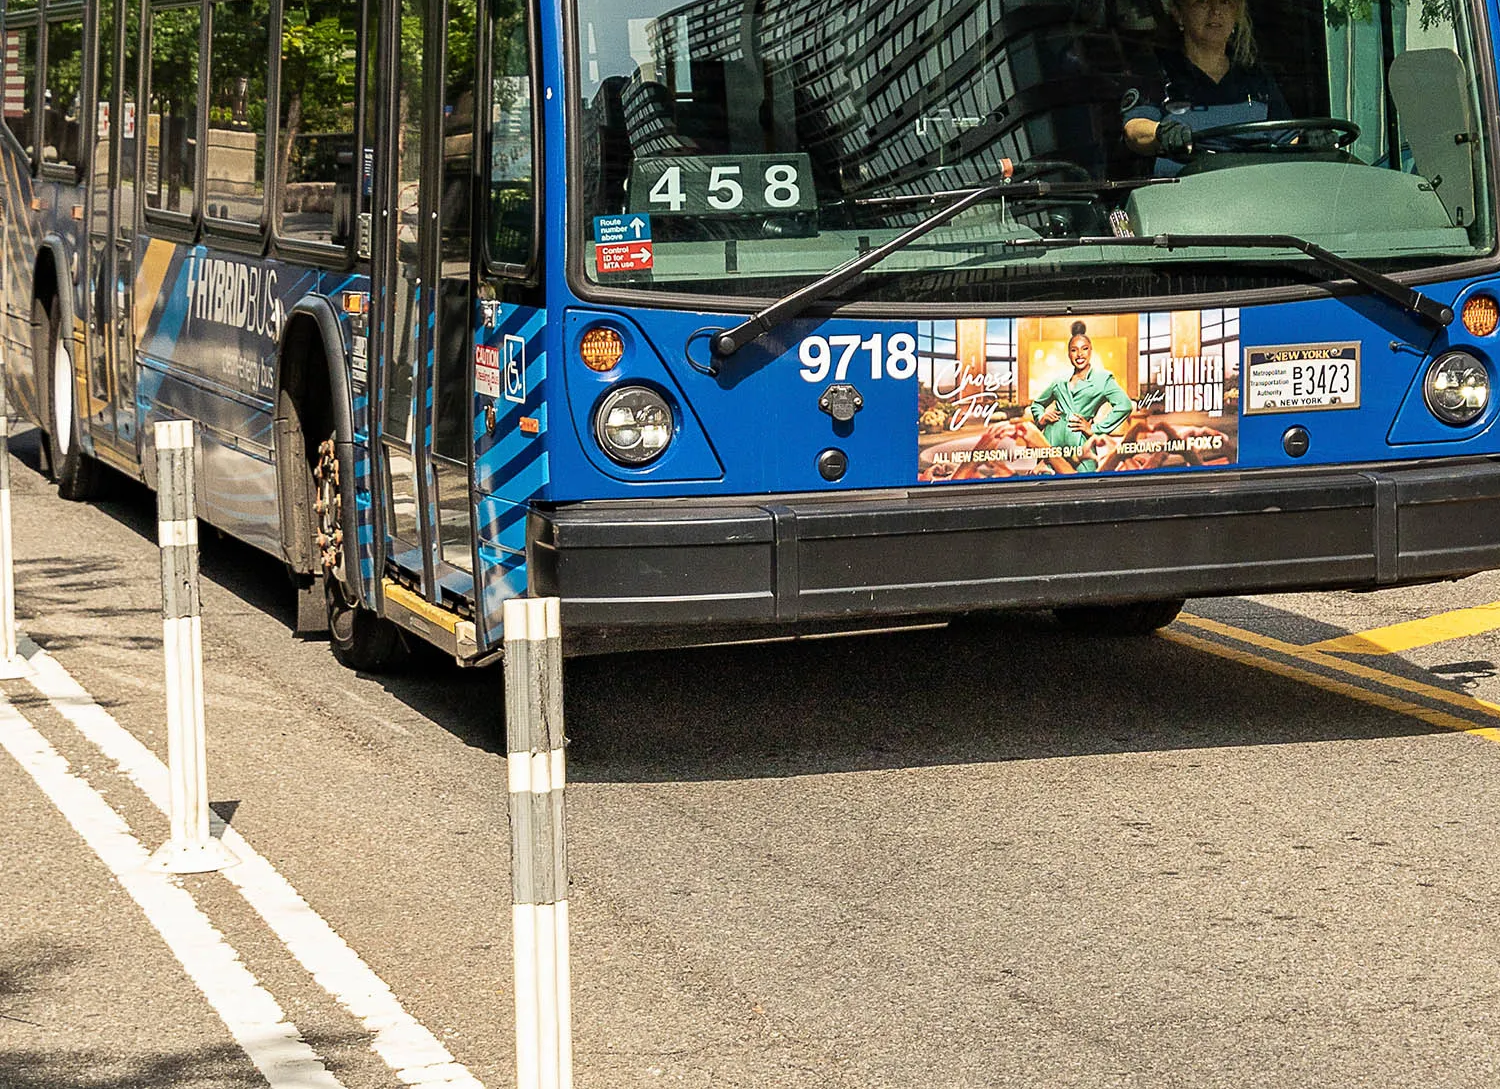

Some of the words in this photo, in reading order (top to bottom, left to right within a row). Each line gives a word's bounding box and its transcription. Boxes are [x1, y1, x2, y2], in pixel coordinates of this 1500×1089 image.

[600, 218, 622, 227] Route
[601, 226, 628, 234] number
[601, 233, 624, 241] above
[602, 246, 629, 255] Control
[603, 262, 621, 270] MTA
[476, 346, 500, 368] CAUTION
[799, 332, 918, 383] 9718
[1274, 351, 1300, 361] NEW
[1302, 349, 1330, 359] YORK
[1156, 355, 1223, 386] JENNIFER
[1252, 369, 1287, 377] Metropolitan
[932, 360, 1016, 399] Choose
[1250, 379, 1289, 387] Transportation
[1164, 383, 1223, 413] HUDSON
[1280, 399, 1299, 407] NEW
[1301, 397, 1323, 405] YORK
[949, 391, 998, 432] Joy
[1116, 442, 1162, 454] WEEKDAYS
[1163, 440, 1185, 452] 11AM
[933, 453, 949, 463] ALL
[951, 451, 972, 462] NEW
[973, 450, 1008, 462] SEASON
[1014, 448, 1062, 459] PREMIERES
